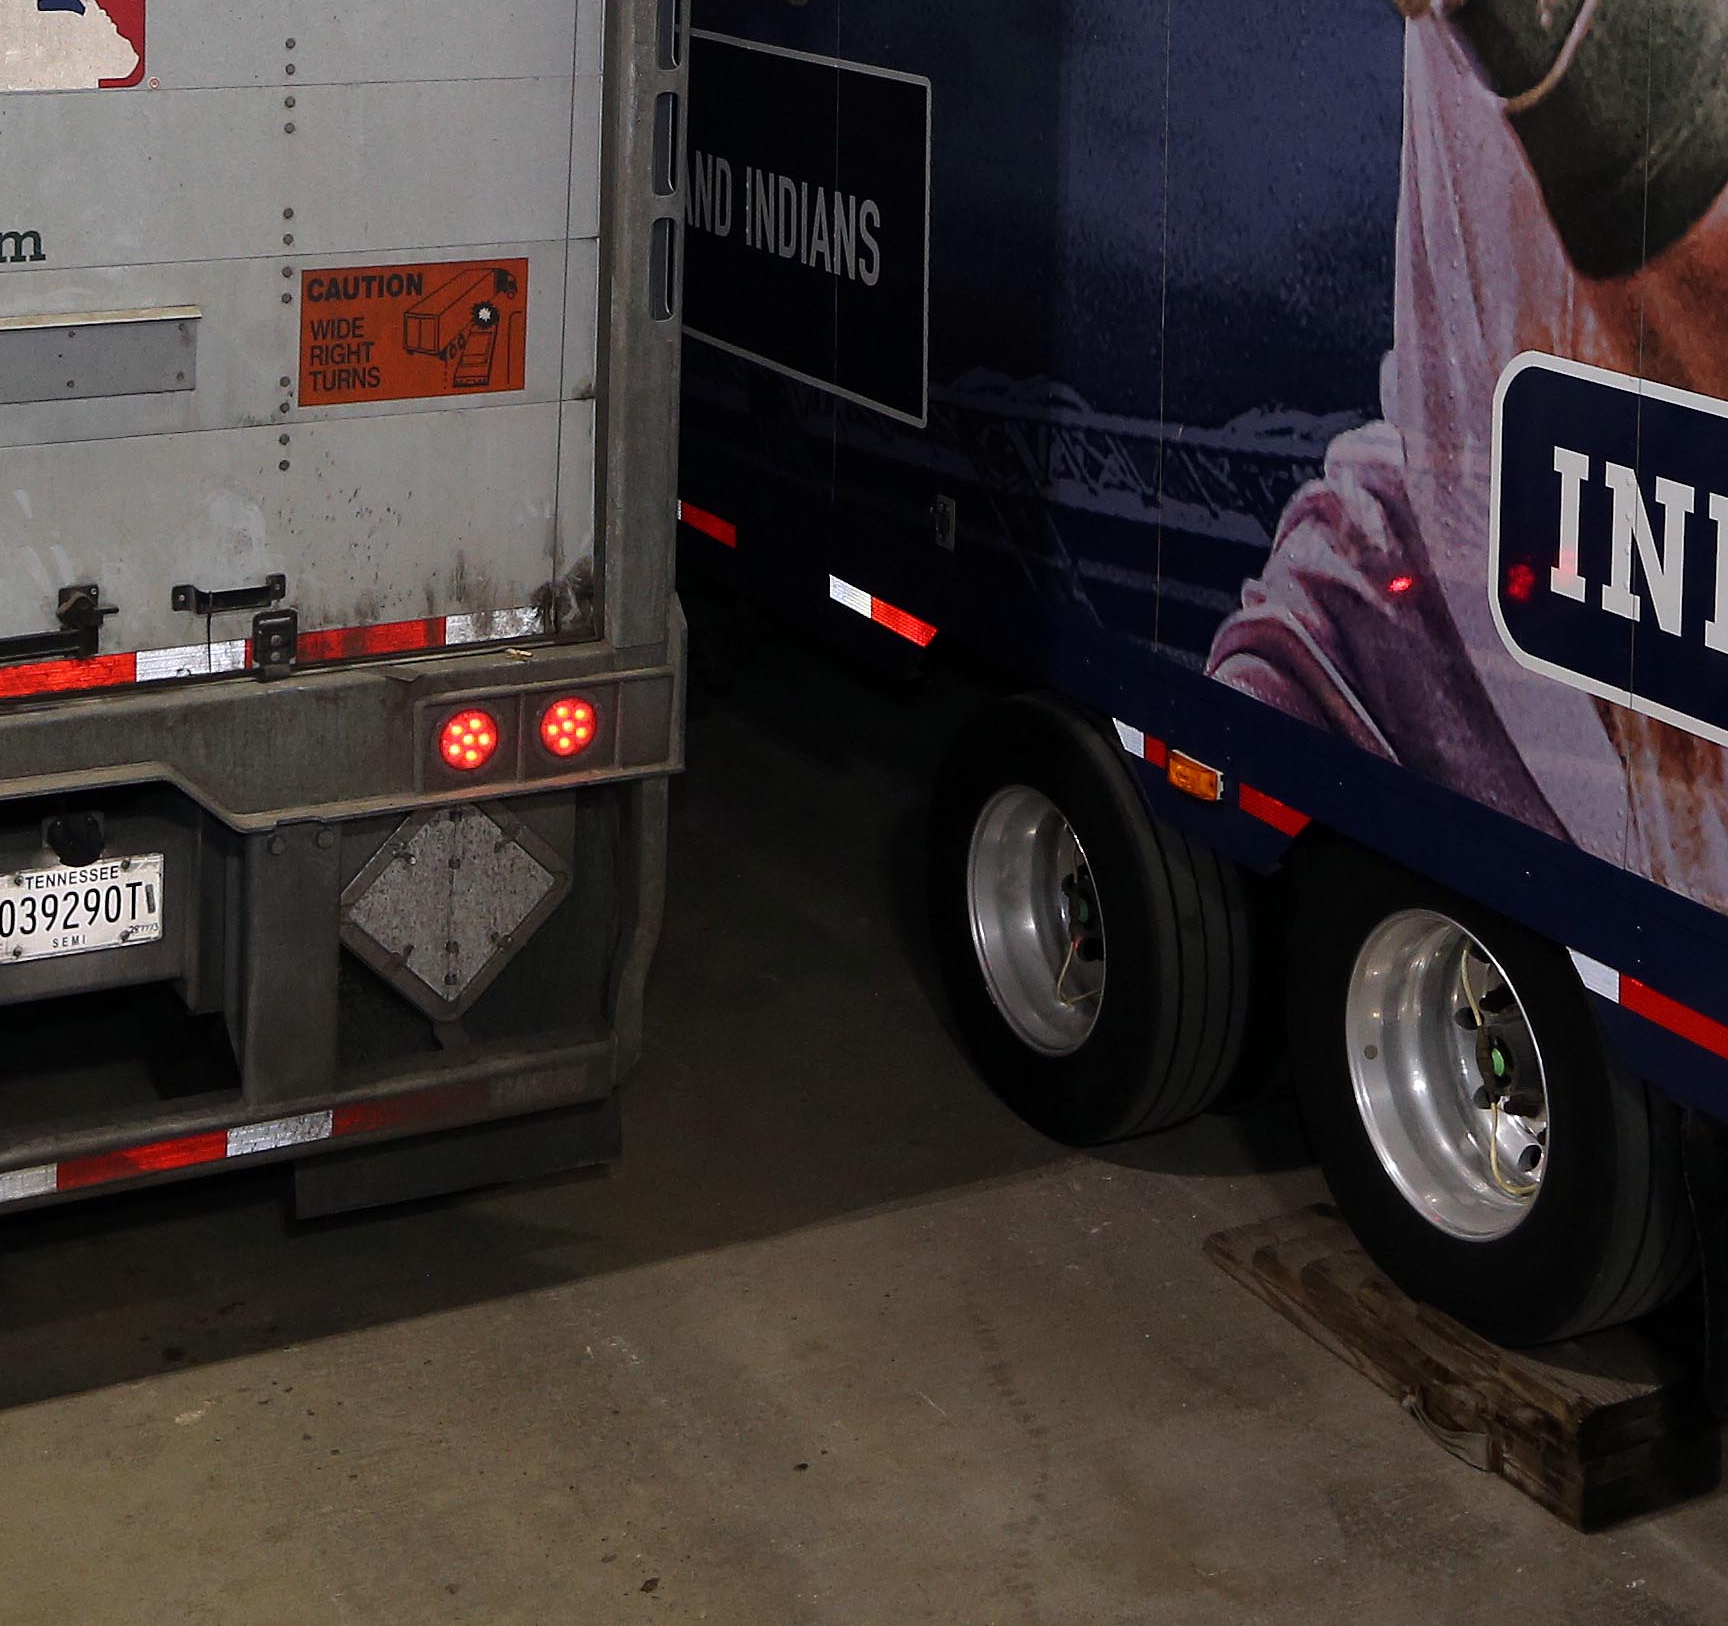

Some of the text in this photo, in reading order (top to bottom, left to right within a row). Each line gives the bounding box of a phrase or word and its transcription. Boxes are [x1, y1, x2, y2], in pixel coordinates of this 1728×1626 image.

[746, 165, 881, 287] INDIANS
[307, 273, 422, 303] CAUTION
[309, 318, 365, 341] WIDE
[309, 341, 375, 368] RIGHT
[309, 366, 381, 392] TURNS
[25, 865, 120, 890] TENNESSEE
[52, 934, 87, 949] SEMI
